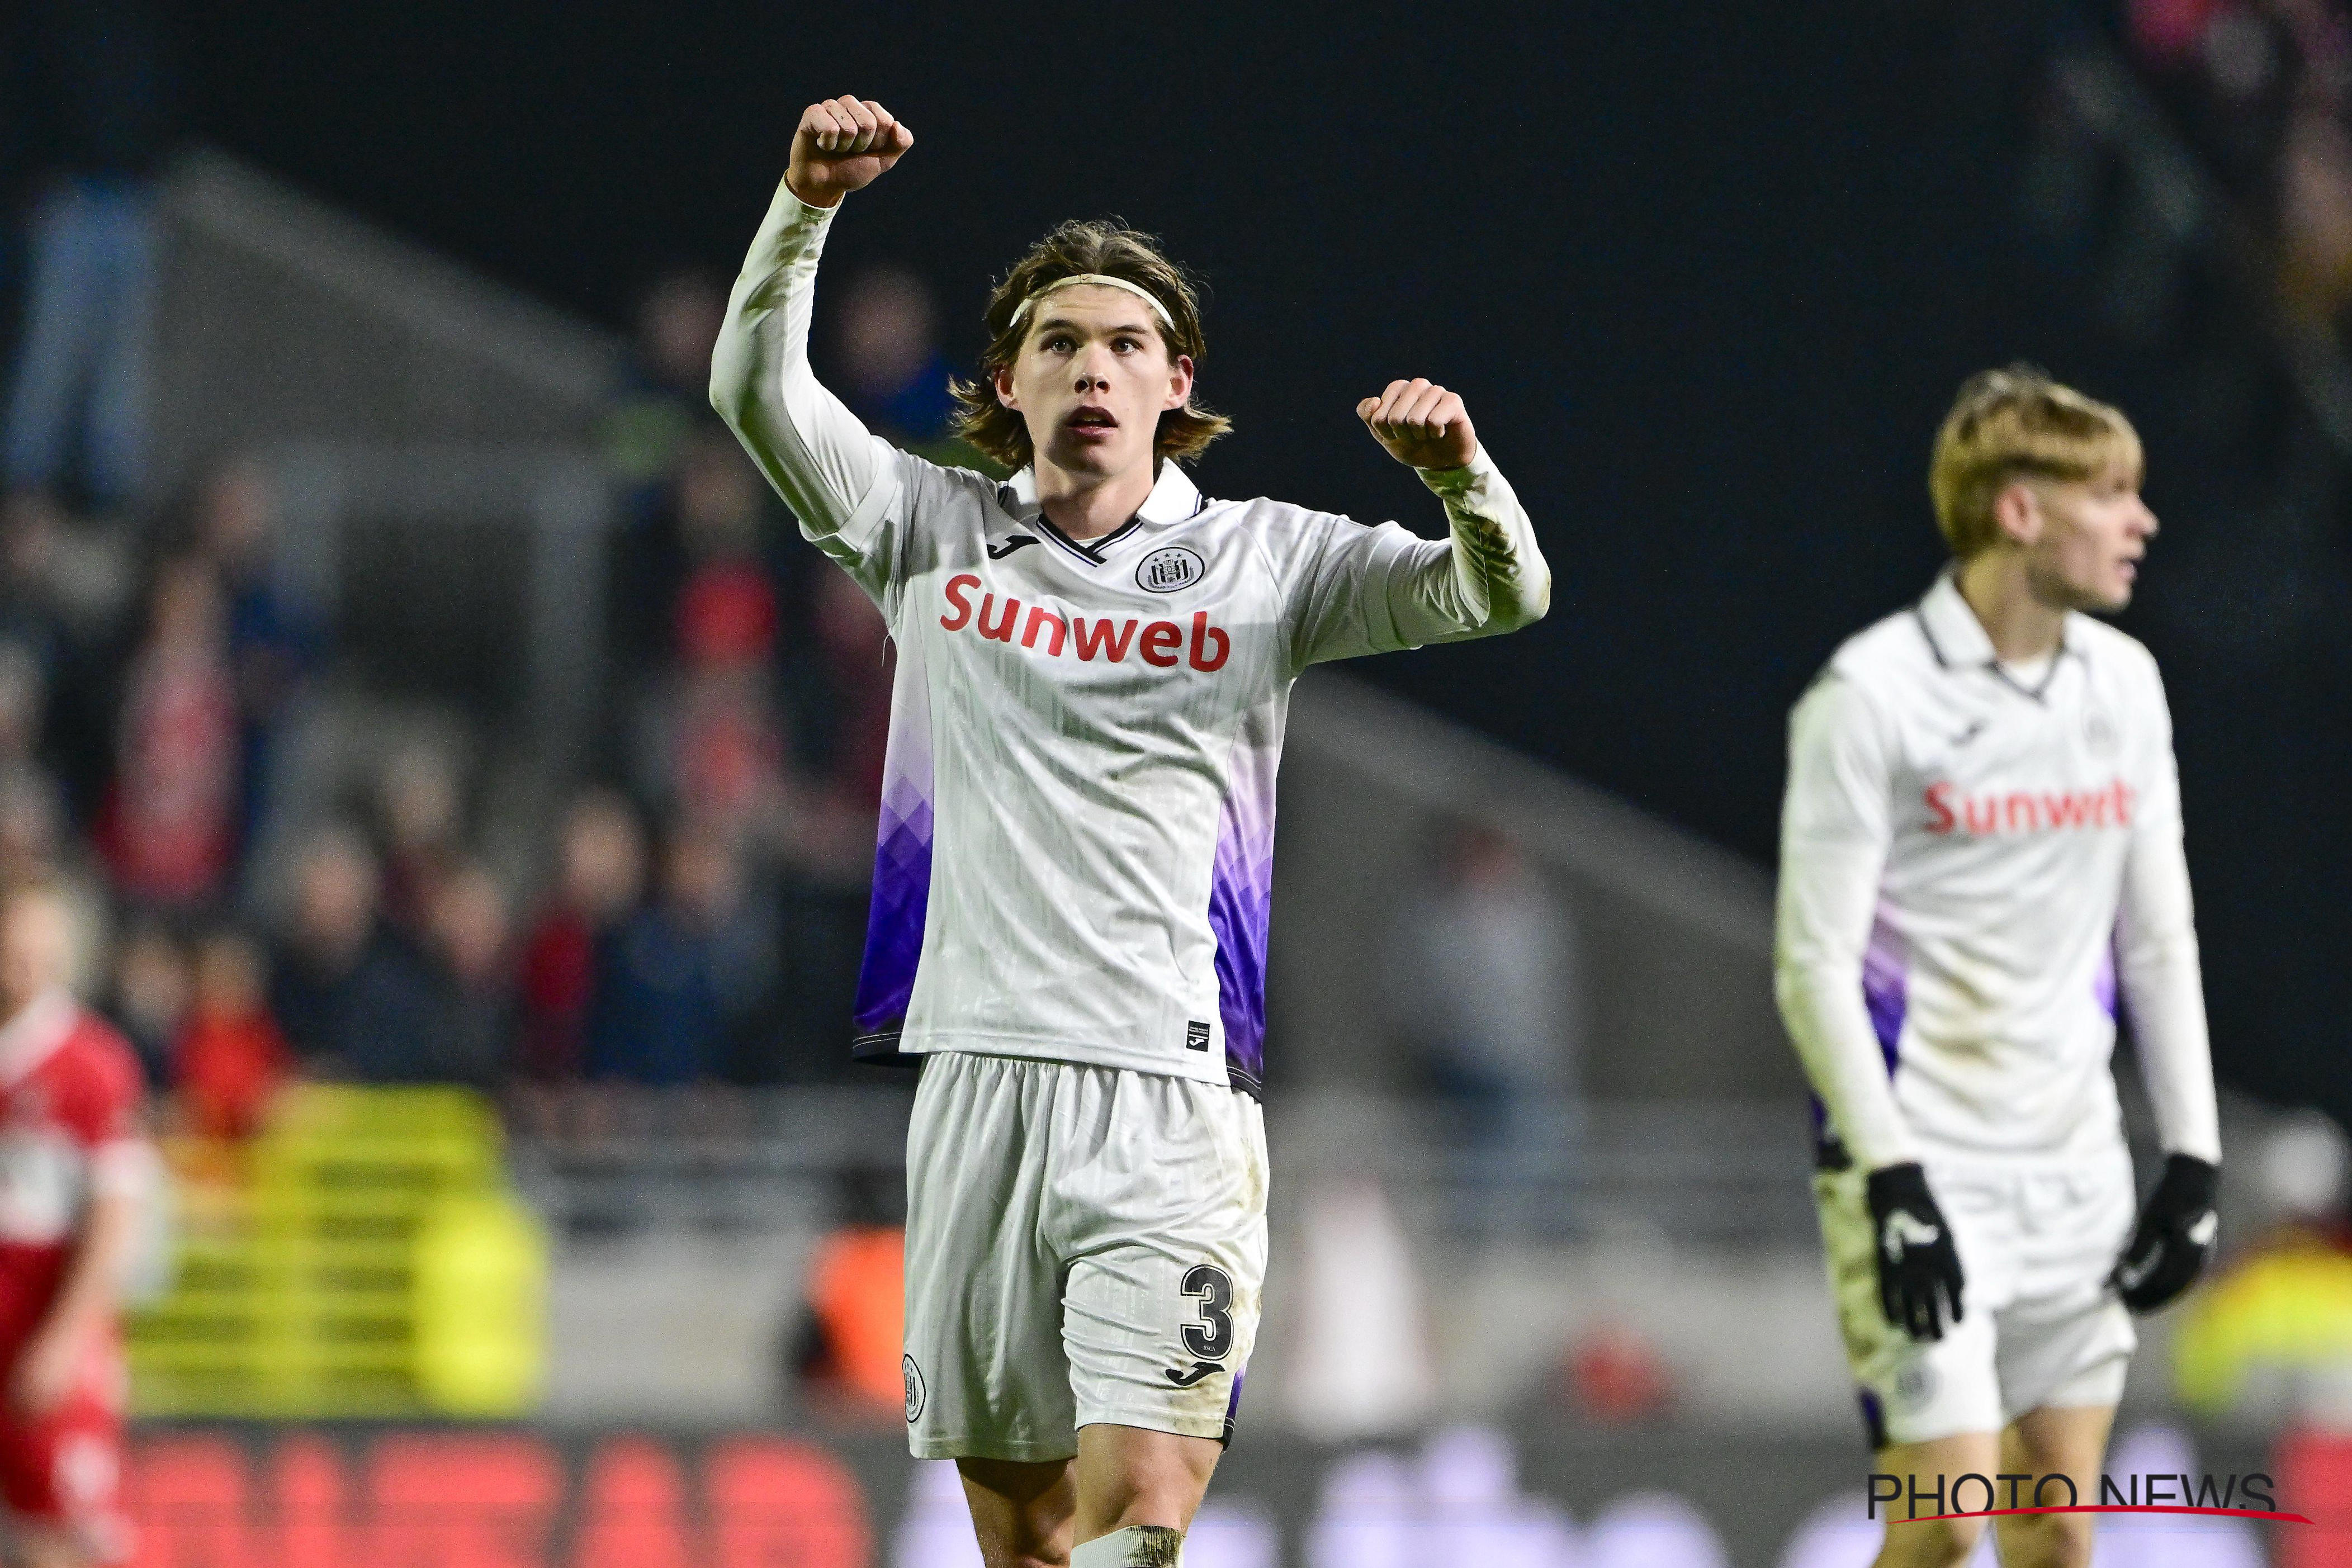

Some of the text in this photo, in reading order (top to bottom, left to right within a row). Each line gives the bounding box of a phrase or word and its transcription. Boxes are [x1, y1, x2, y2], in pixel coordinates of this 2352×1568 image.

[940, 574, 1230, 672] Sunweb
[1922, 778, 2132, 835] Sunw
[1180, 1264, 1234, 1360] 3
